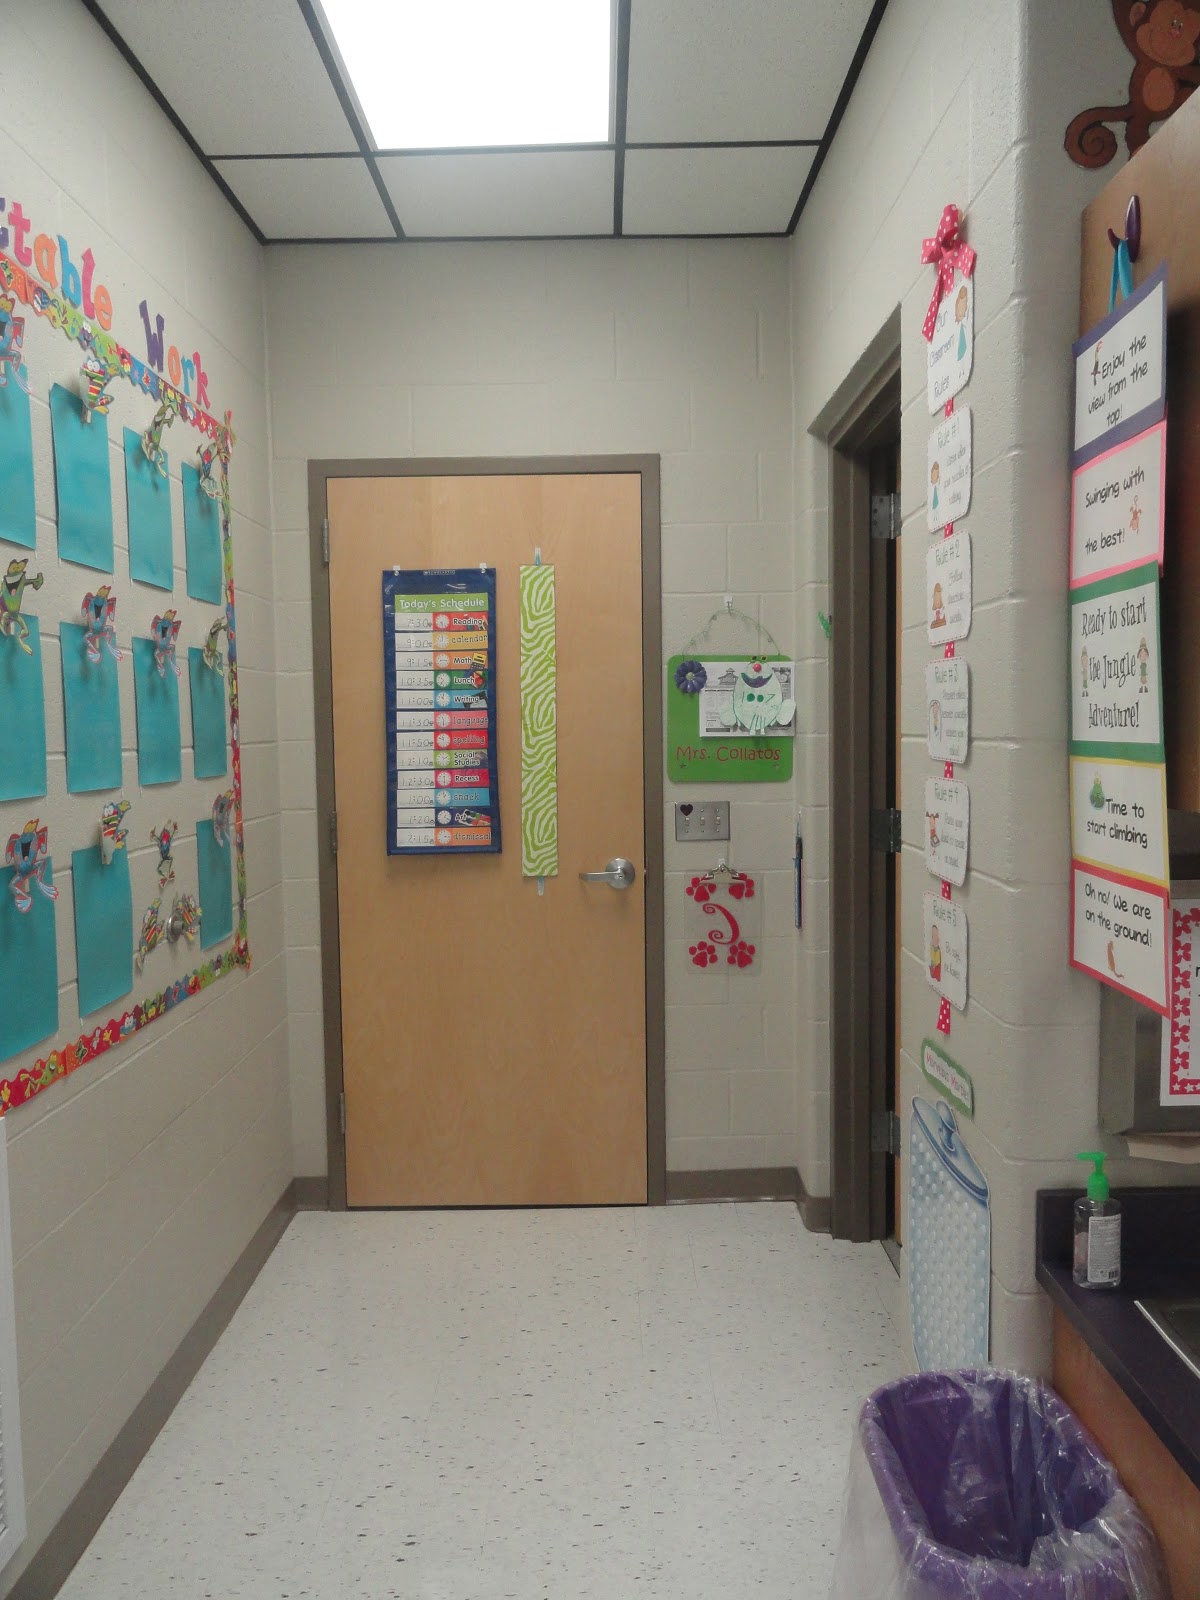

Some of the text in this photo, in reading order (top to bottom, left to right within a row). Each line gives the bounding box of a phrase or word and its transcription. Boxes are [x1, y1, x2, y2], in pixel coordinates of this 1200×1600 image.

[139, 300, 211, 409] Work
[1102, 334, 1147, 380] Enjoy the
[1088, 361, 1148, 414] view from the
[1106, 403, 1123, 427] top!
[1085, 465, 1145, 509] Swinging with
[1085, 527, 1126, 555] the best!
[400, 597, 485, 610] Today's Schedule
[453, 618, 483, 626] Reading
[1082, 596, 1147, 639] Ready to start
[406, 639, 428, 648] 9:00
[452, 634, 488, 644] calendar
[406, 658, 428, 668] 9:15
[454, 657, 472, 665] Math
[1089, 651, 1136, 690] the Jungle
[400, 678, 428, 686] 10:35
[400, 697, 428, 706] 11:00
[454, 696, 479, 704] Writing
[400, 718, 429, 727] 11:30
[453, 716, 488, 726] language
[1088, 700, 1140, 729] Adventure!
[453, 735, 485, 746] spelling
[676, 744, 781, 762] Mrs. Collatos
[453, 792, 480, 800] snack
[455, 812, 467, 821] Art
[1106, 798, 1145, 819] Time to
[453, 832, 492, 840] dismissal
[1087, 820, 1148, 849] start climbing
[1085, 882, 1152, 920] Oh no! We are
[1085, 909, 1152, 948] on the ground!
